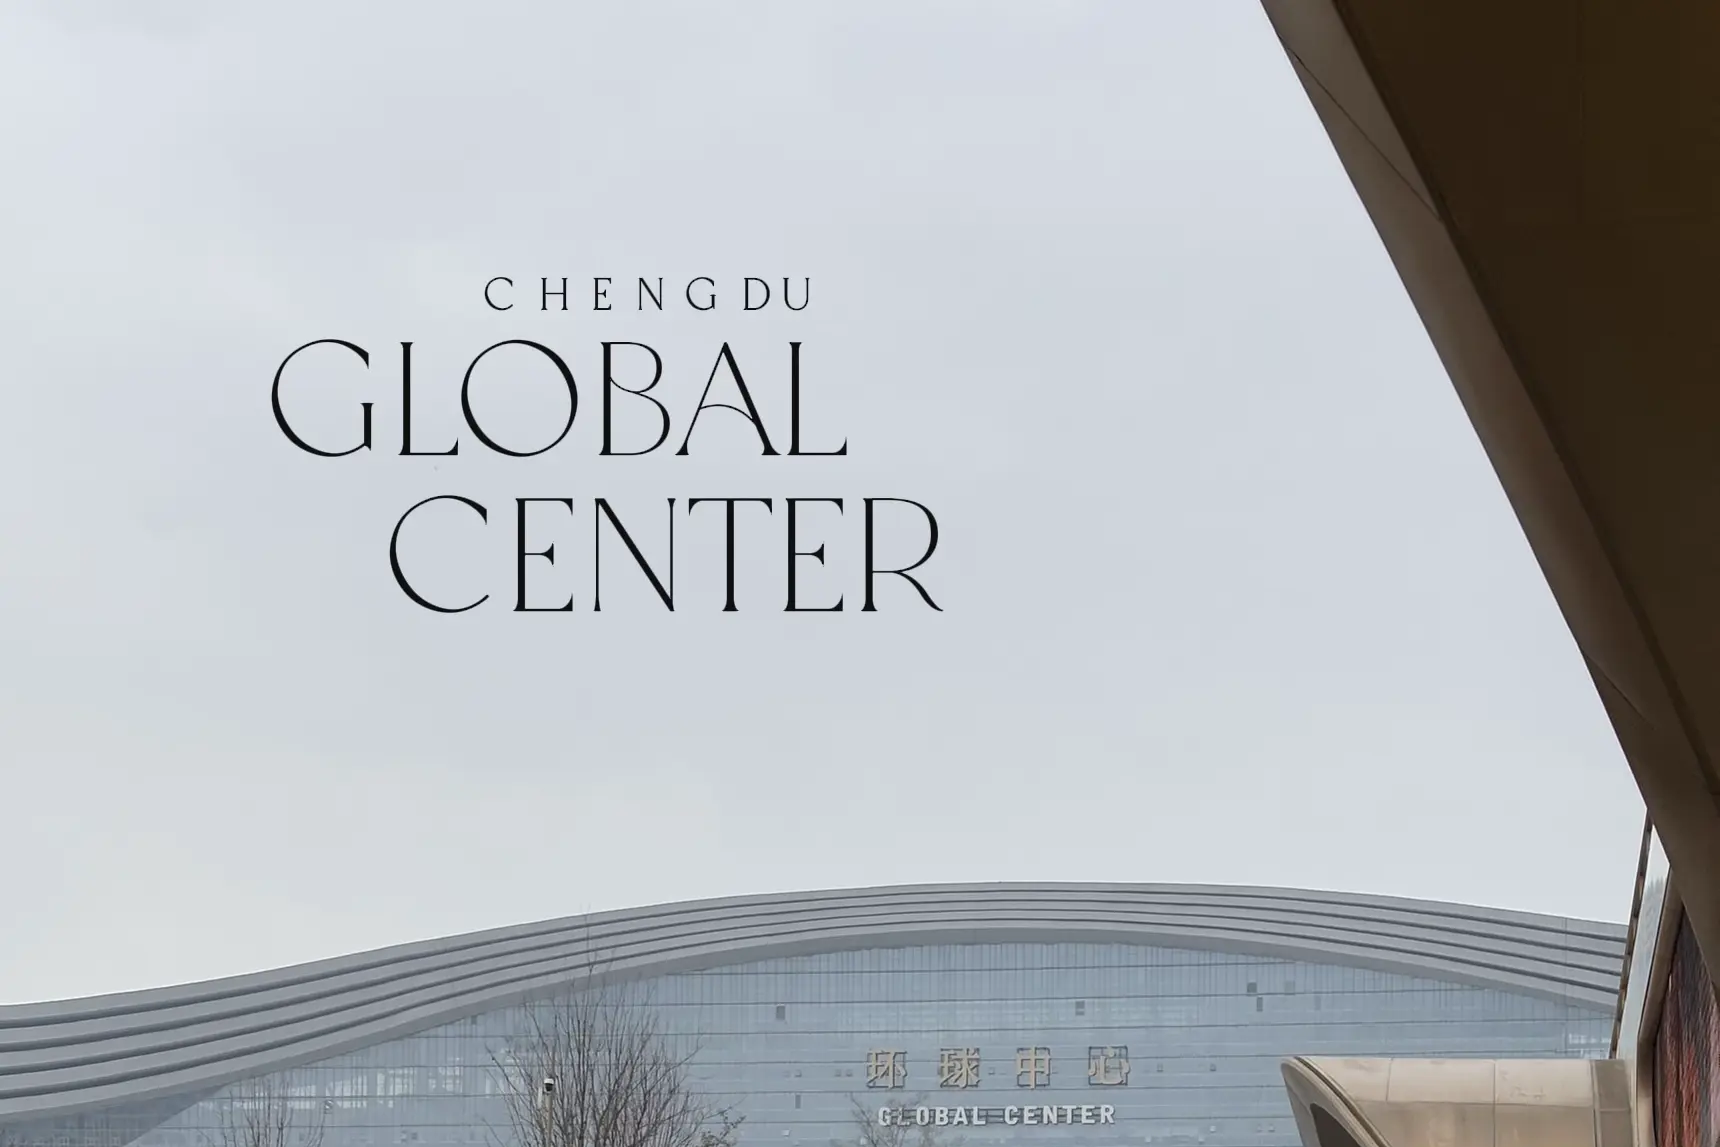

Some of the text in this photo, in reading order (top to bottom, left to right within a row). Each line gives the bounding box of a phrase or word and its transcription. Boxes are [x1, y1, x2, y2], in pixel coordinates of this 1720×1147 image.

[866, 1045, 1130, 1089] 环球中心
[878, 1104, 1116, 1126] GLOBAL CENTER
